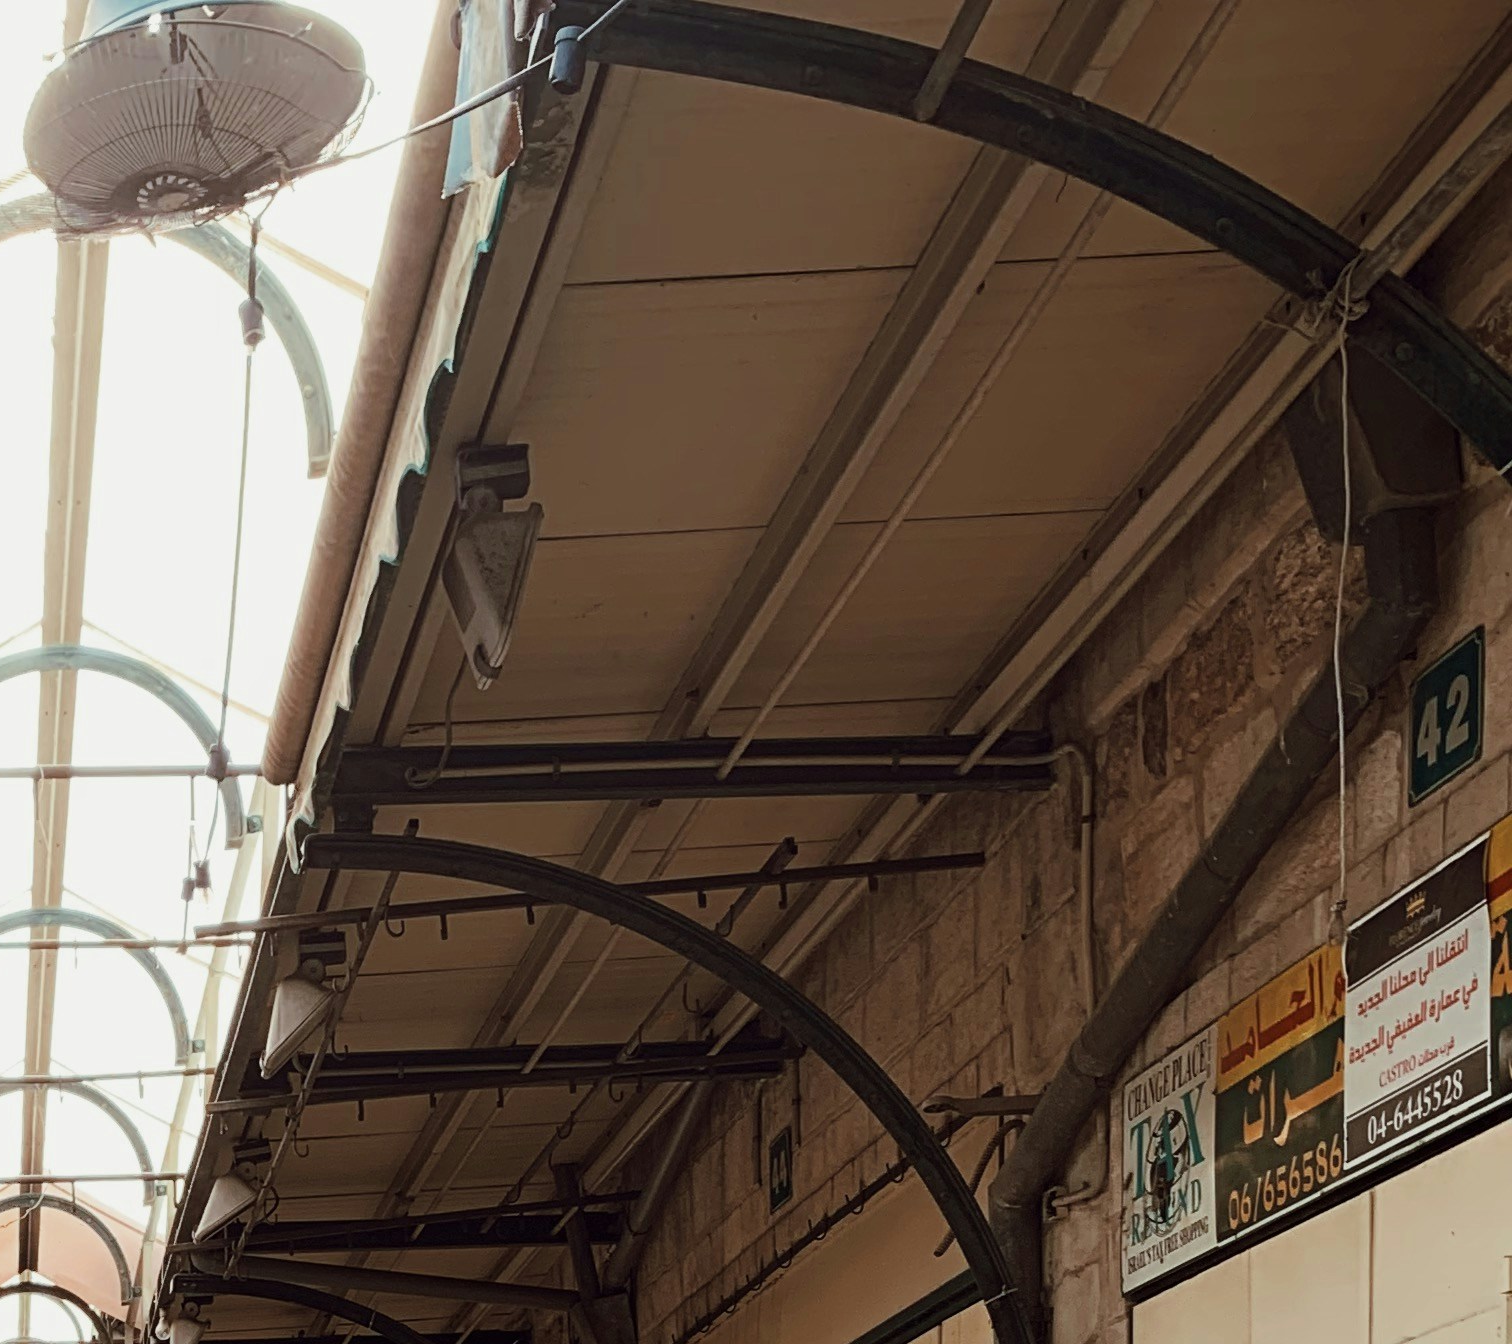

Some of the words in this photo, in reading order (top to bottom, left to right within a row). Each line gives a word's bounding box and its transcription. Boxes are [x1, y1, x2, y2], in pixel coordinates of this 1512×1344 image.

[1416, 673, 1470, 767] 42
[1432, 928, 1469, 971] انتقلنا
[1357, 979, 1387, 1018] الجديد
[1389, 970, 1416, 997] محلنا
[1428, 987, 1460, 1022] عمارة
[1462, 972, 1478, 1010] في
[1349, 1025, 1384, 1064] الجديدة
[1386, 1000, 1427, 1054] العفيفي
[1128, 1064, 1170, 1121] CHANGE
[1379, 1054, 1417, 1088] CASTRO
[1366, 1068, 1464, 1145] 04-6445528
[1130, 1081, 1206, 1202] TAX
[1228, 1132, 1343, 1230] 06/656586
